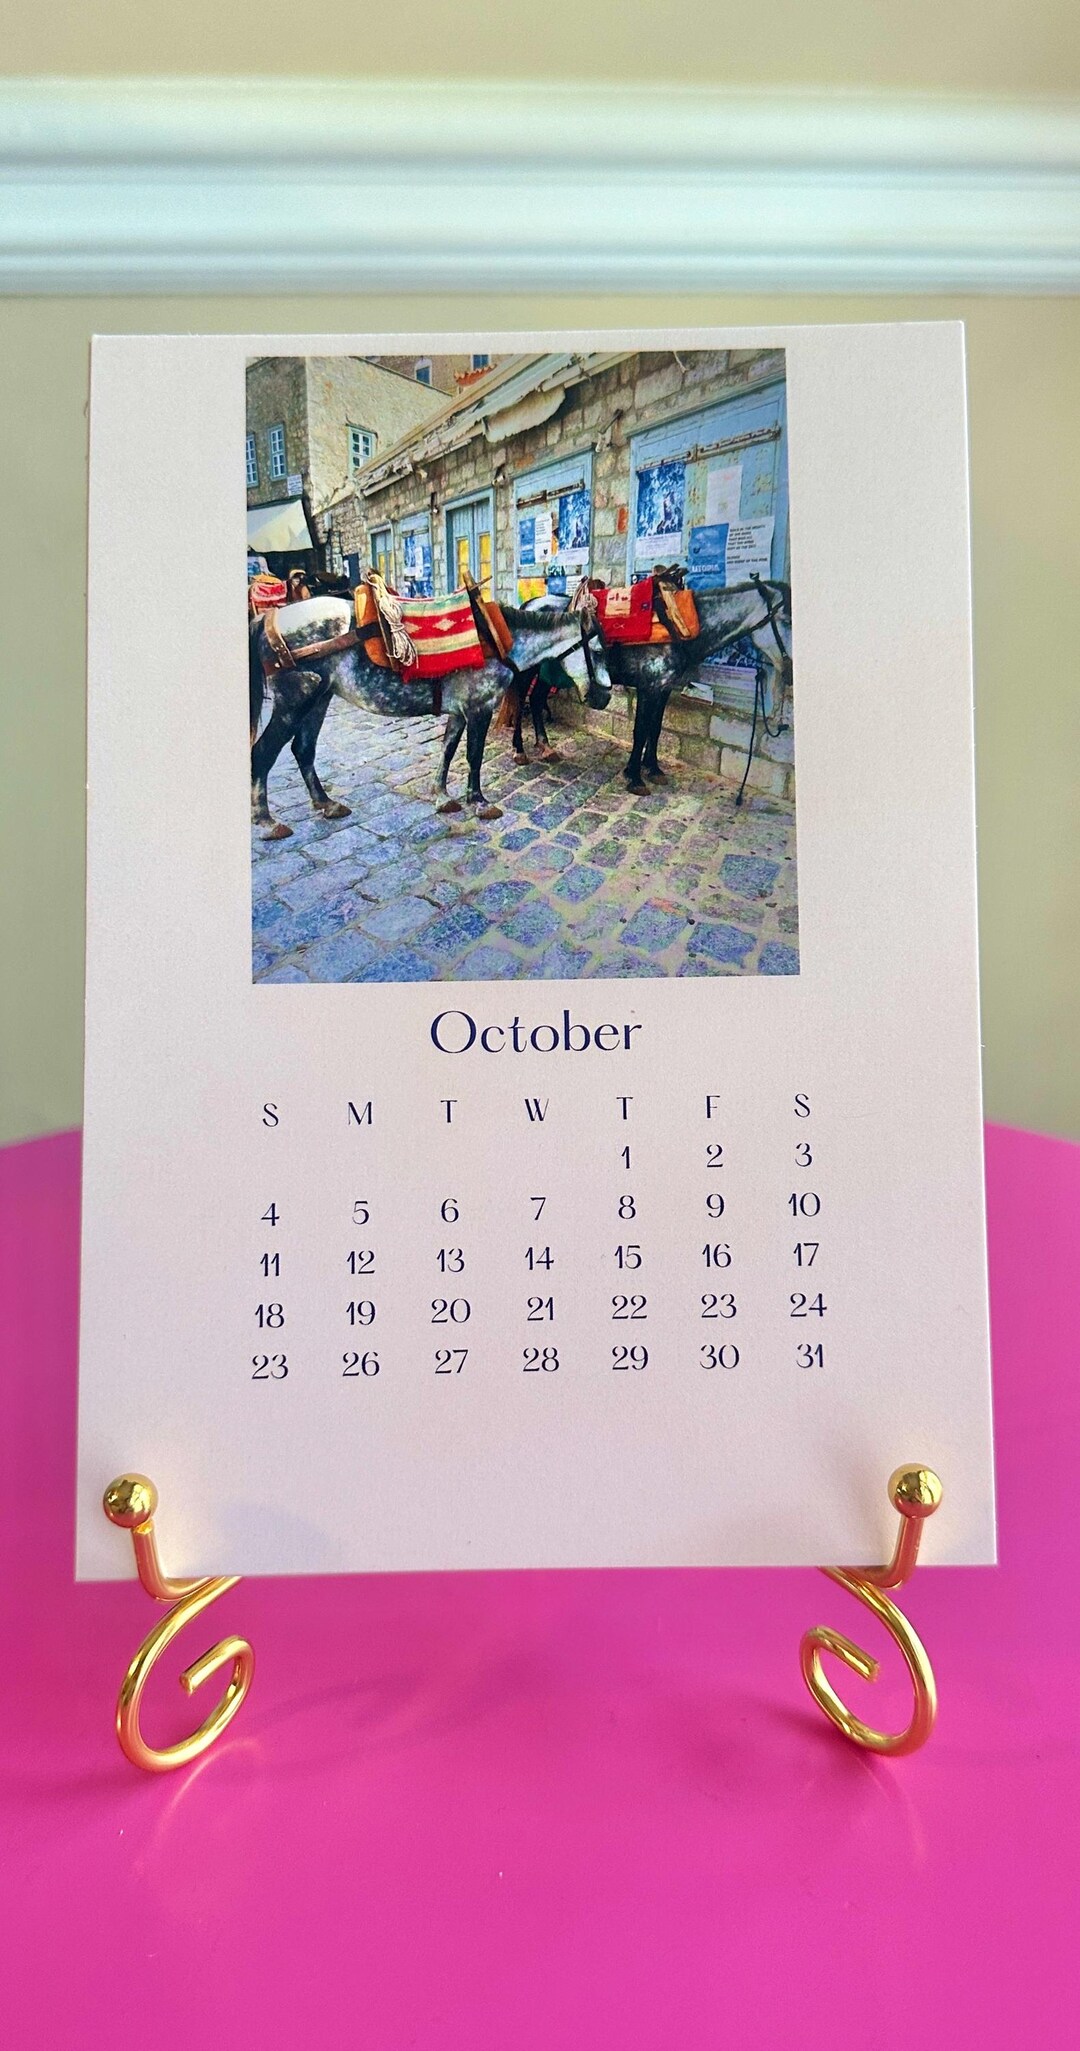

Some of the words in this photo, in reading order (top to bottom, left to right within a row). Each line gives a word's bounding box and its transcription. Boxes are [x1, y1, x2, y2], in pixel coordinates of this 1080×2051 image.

[431, 1010, 642, 1053] October
[263, 1103, 278, 1127] S
[348, 1102, 372, 1125] M
[440, 1100, 457, 1123] T
[525, 1099, 549, 1121] W
[616, 1097, 633, 1120] T
[706, 1095, 720, 1118] F
[794, 1094, 810, 1118] S
[621, 1146, 630, 1169] 1
[707, 1144, 723, 1168] 2
[795, 1143, 812, 1167] 3
[261, 1203, 280, 1226] 4
[352, 1201, 369, 1225] 5
[441, 1199, 459, 1223] 6
[530, 1197, 546, 1220] 7
[618, 1195, 636, 1219] 8
[706, 1194, 724, 1218] 9
[788, 1193, 820, 1217] 10
[260, 1253, 279, 1277] 11
[347, 1250, 375, 1274] 12
[437, 1248, 465, 1272] 13
[525, 1247, 554, 1270] 14
[614, 1245, 642, 1269] 15
[702, 1244, 731, 1268] 16
[793, 1243, 819, 1266] 17
[255, 1303, 284, 1328] 18
[346, 1301, 375, 1325] 19
[431, 1299, 471, 1323] 20
[527, 1297, 553, 1321] 21
[612, 1295, 647, 1319] 22
[701, 1294, 737, 1318] 23
[790, 1293, 827, 1317] 24
[252, 1354, 288, 1379] 23
[342, 1352, 379, 1377] 26
[435, 1349, 468, 1374] 27
[523, 1347, 559, 1372] 28
[612, 1346, 648, 1370] 29
[700, 1345, 739, 1369] 30
[796, 1344, 823, 1369] 31
